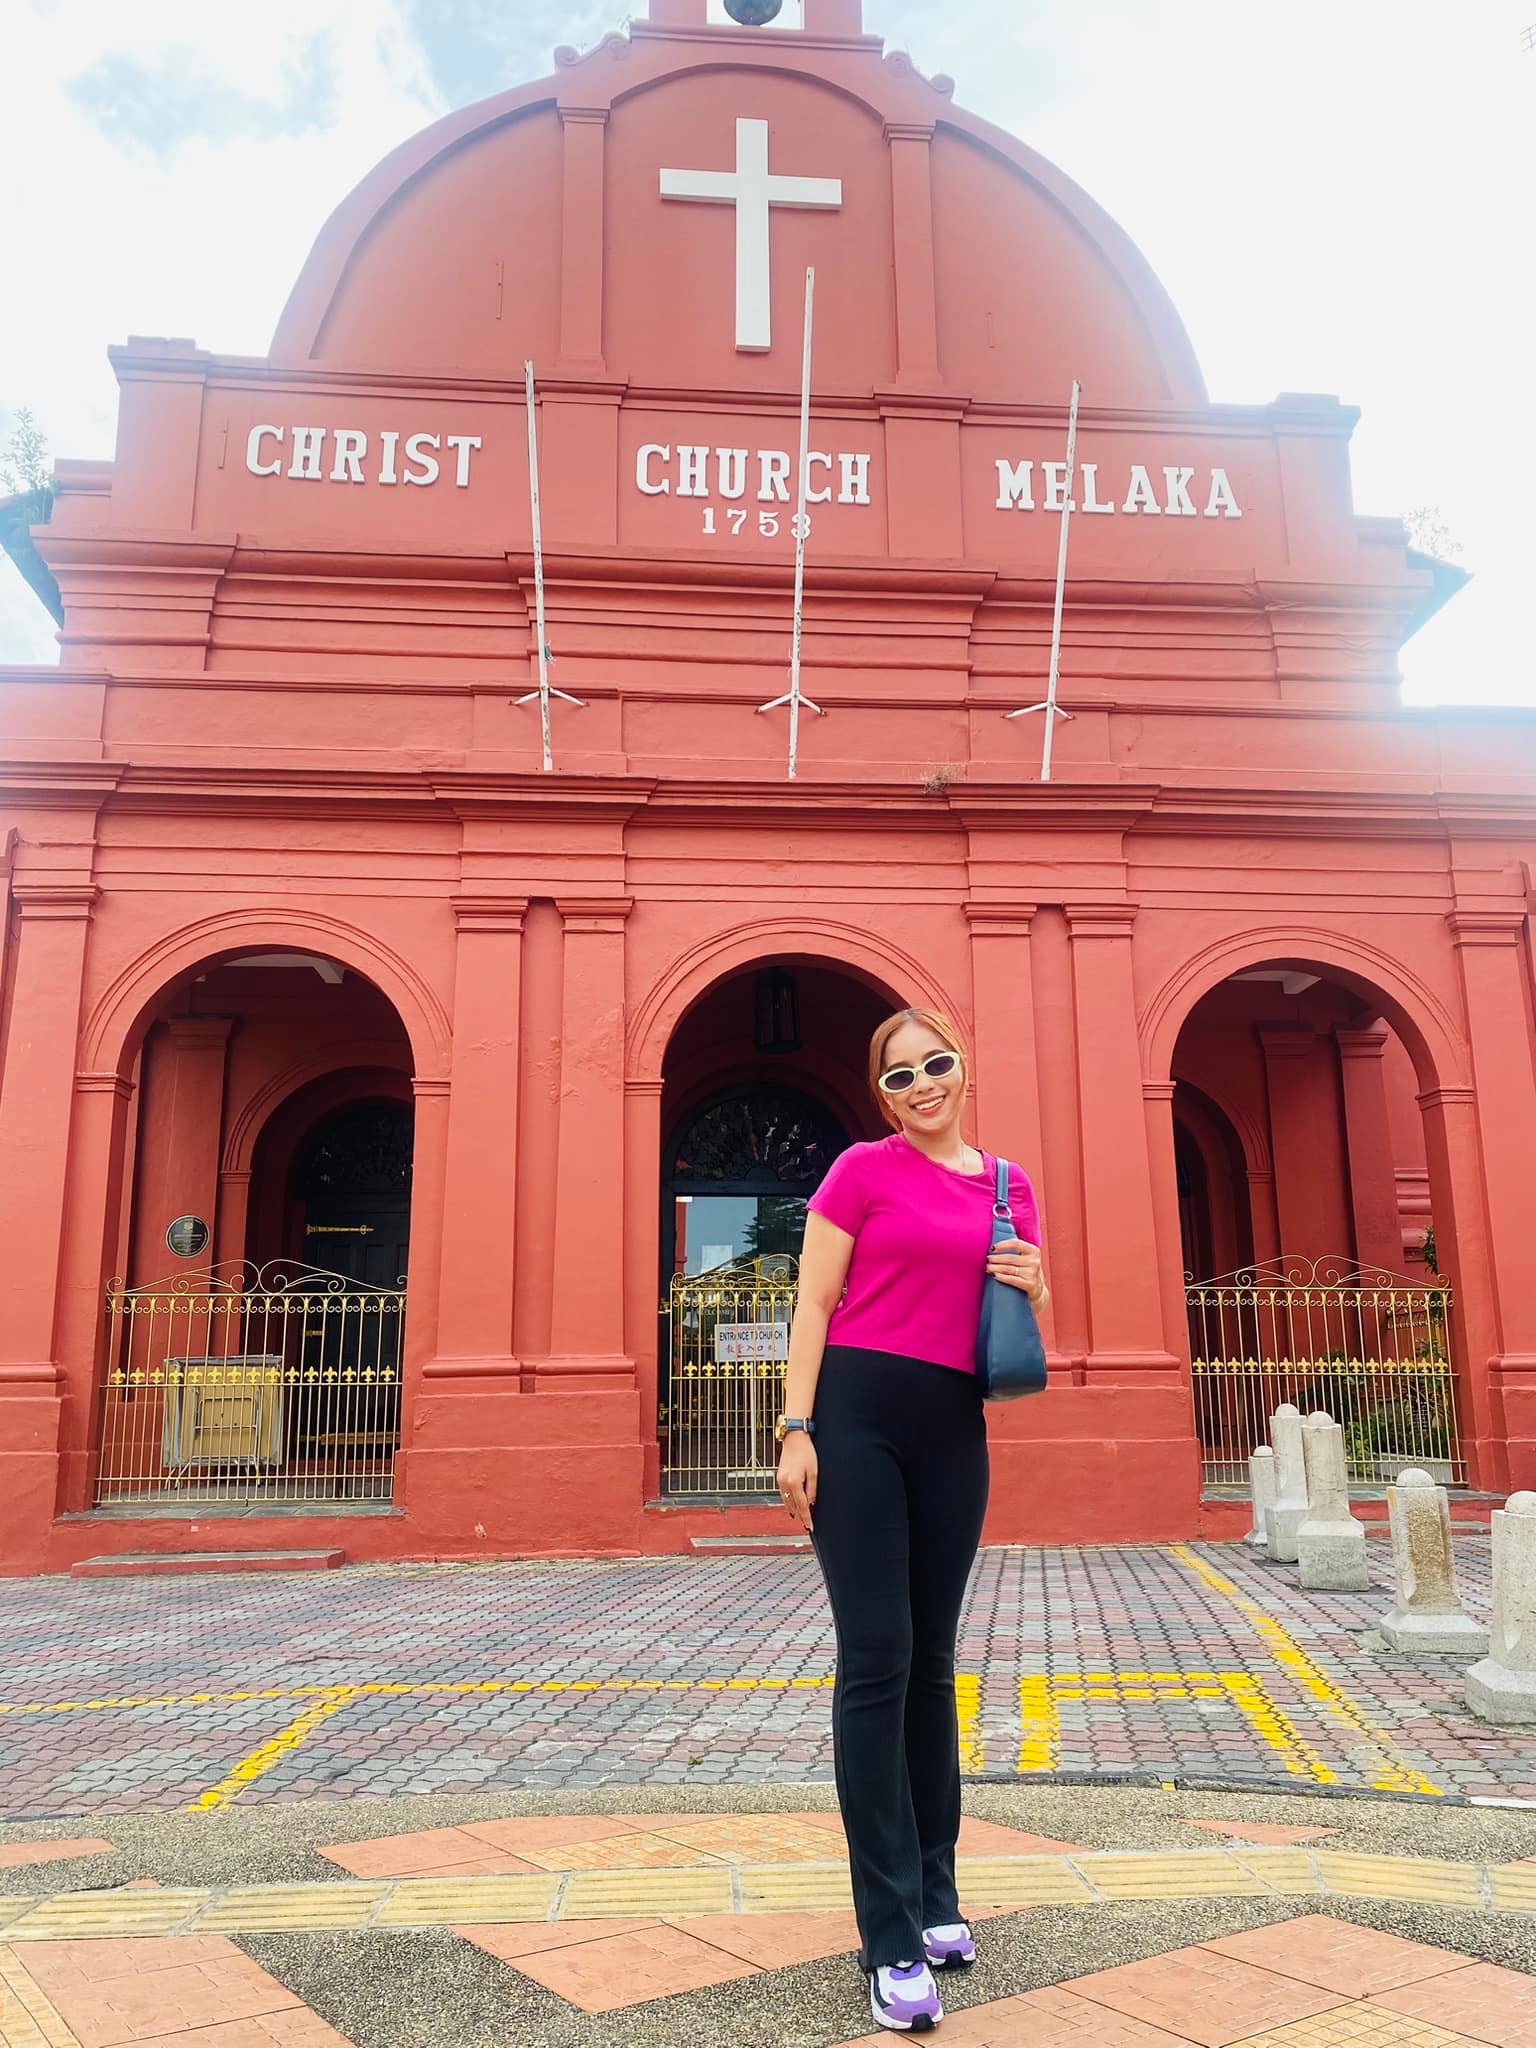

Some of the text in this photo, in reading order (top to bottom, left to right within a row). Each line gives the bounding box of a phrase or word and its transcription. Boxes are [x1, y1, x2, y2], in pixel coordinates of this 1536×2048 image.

[246, 424, 1242, 517] CHRIST CHURCH MELAKA
[702, 507, 811, 538] 1753
